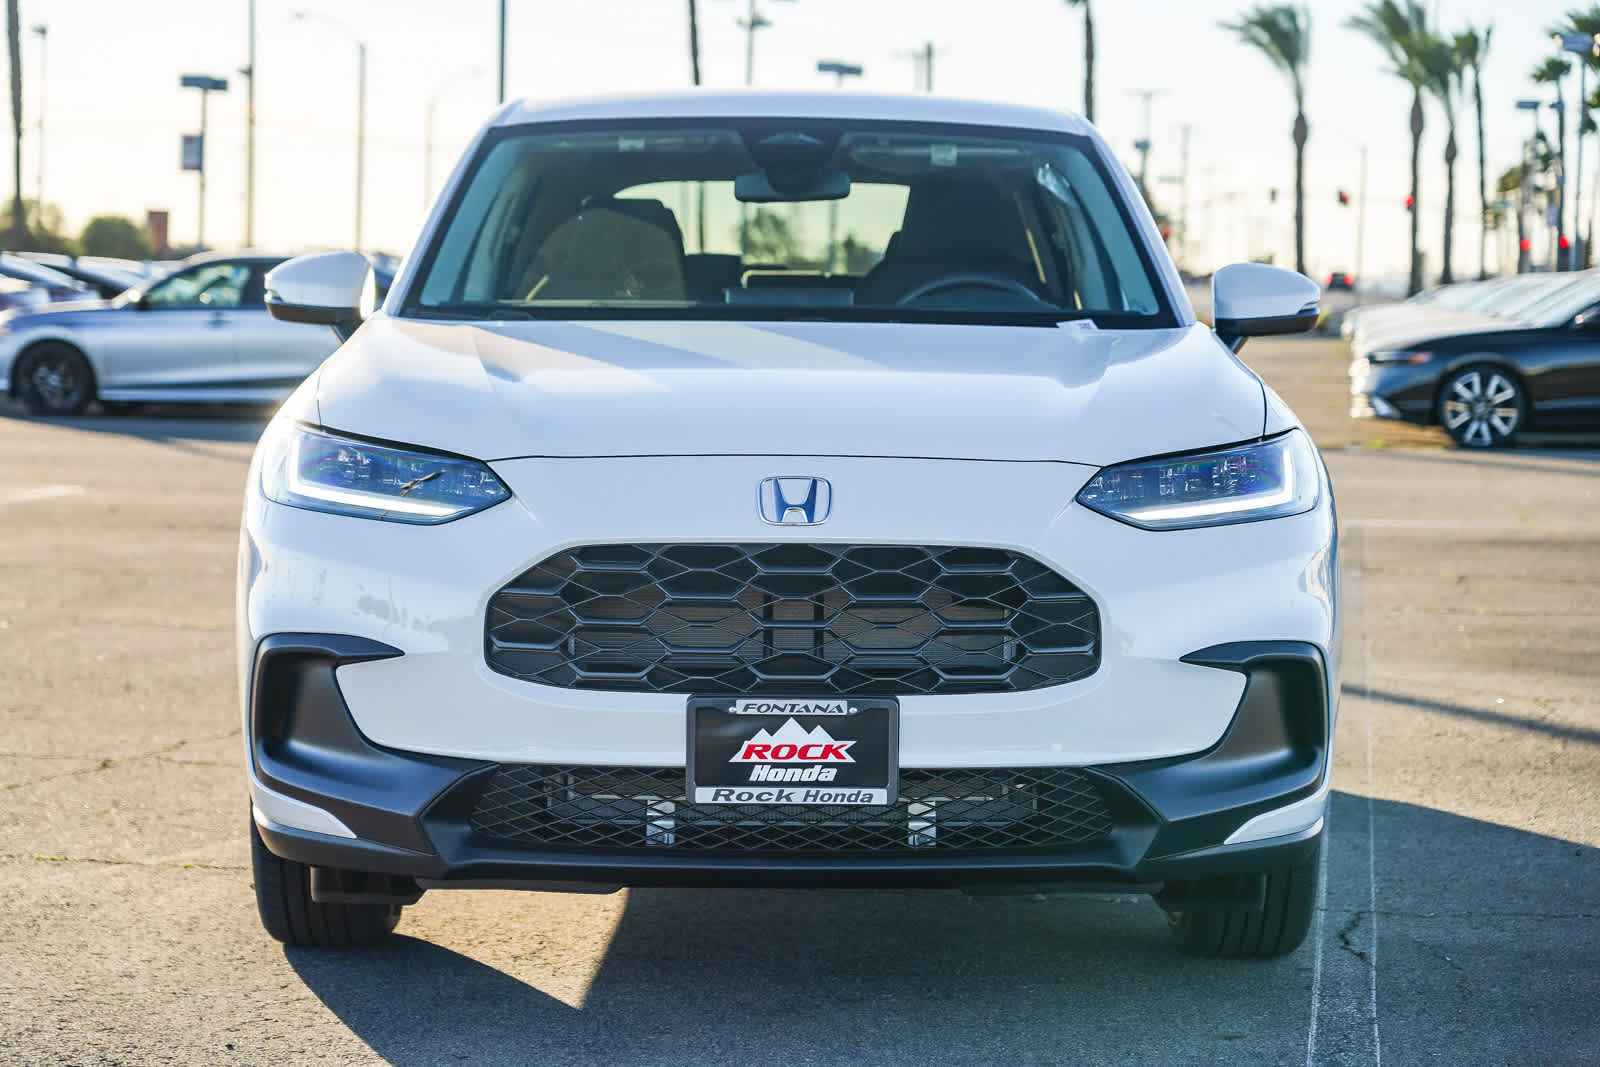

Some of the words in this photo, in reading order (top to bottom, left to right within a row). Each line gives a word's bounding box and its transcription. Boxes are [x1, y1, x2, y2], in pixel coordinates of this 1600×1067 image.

[742, 703, 844, 713] FONTANA
[742, 744, 847, 760] ROCK
[749, 764, 837, 781] Honda
[711, 788, 799, 802] Rock
[803, 789, 874, 803] Honda
